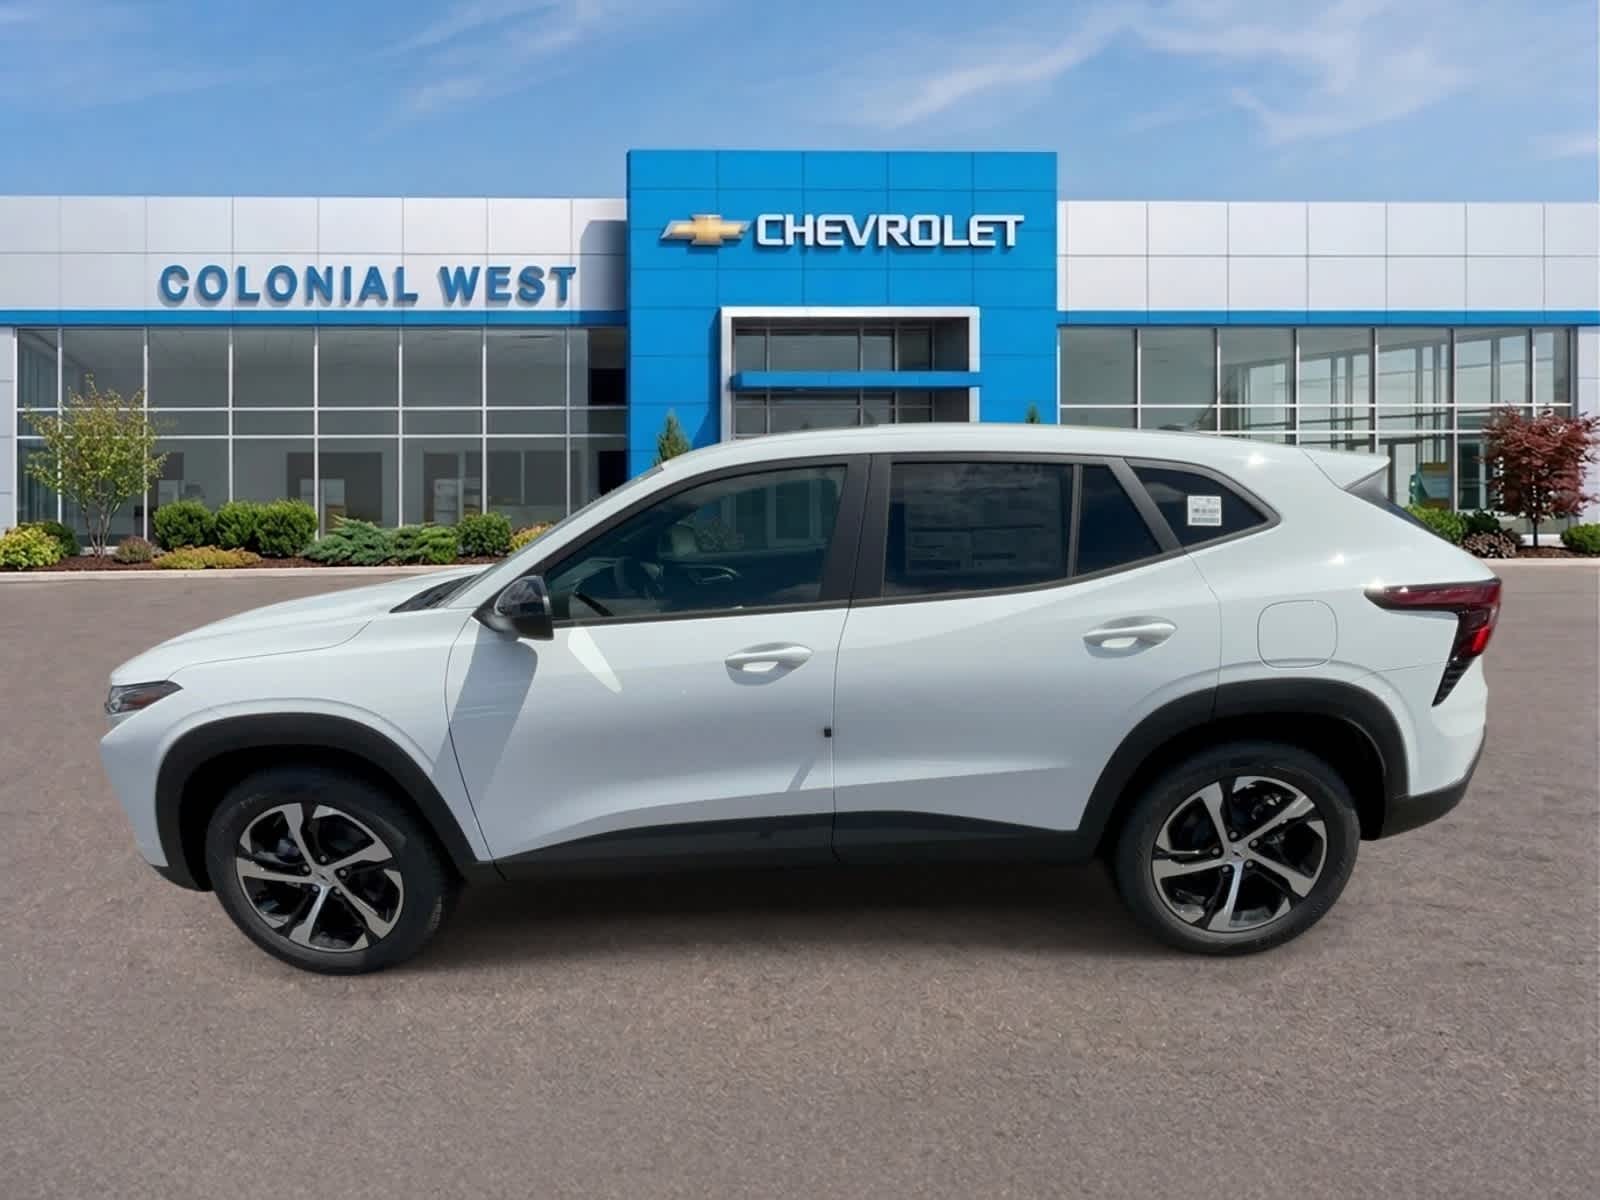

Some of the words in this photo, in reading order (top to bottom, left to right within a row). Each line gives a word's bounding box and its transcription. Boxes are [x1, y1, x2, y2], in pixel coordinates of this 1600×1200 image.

[756, 213, 1025, 247] CHEVROLET
[159, 265, 418, 303] COLONIAL
[439, 265, 577, 303] WEST
